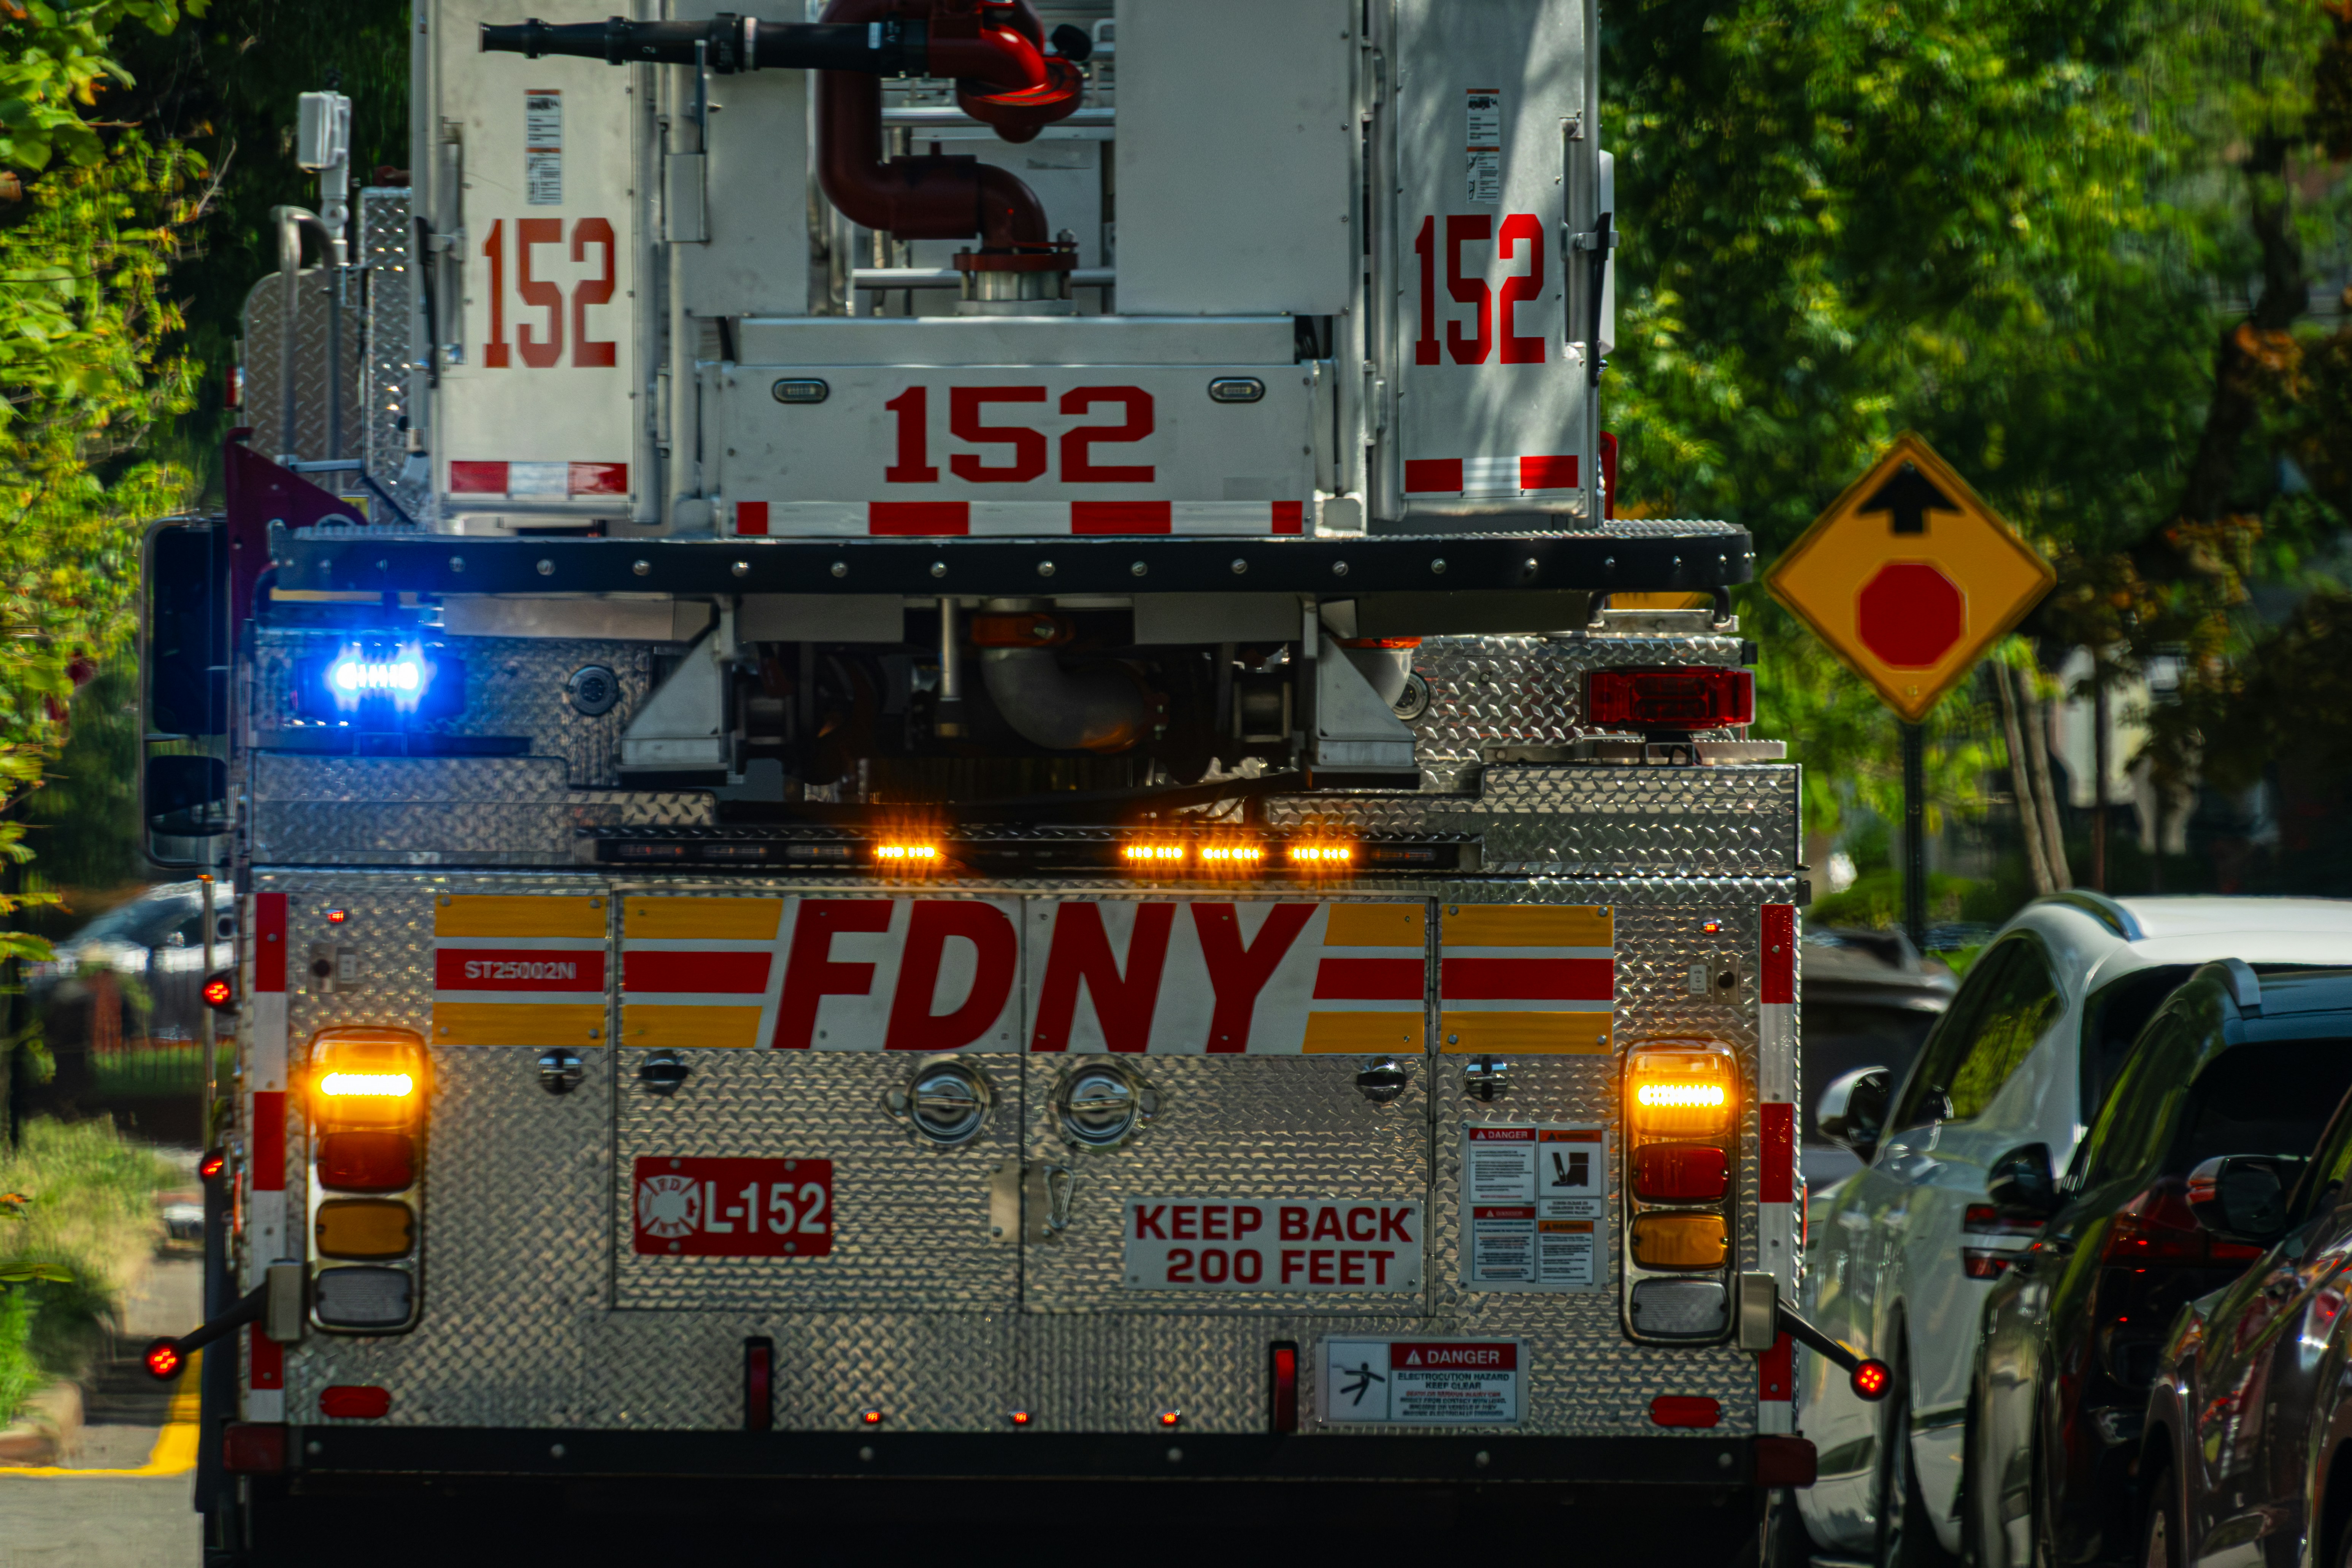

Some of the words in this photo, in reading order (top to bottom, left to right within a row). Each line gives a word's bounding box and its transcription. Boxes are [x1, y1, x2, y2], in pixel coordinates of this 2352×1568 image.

[481, 217, 616, 368] 152
[1415, 213, 1545, 366] 152
[885, 385, 1155, 483] 152
[465, 960, 576, 979] ST25002N
[771, 899, 1320, 1053] FDNY
[704, 1181, 826, 1234] L-152
[1135, 1205, 1263, 1240] KEEP
[1279, 1207, 1413, 1242] BACK
[1167, 1249, 1263, 1284] 200
[1281, 1250, 1395, 1285] FEET
[1427, 1350, 1500, 1364] DANGER
